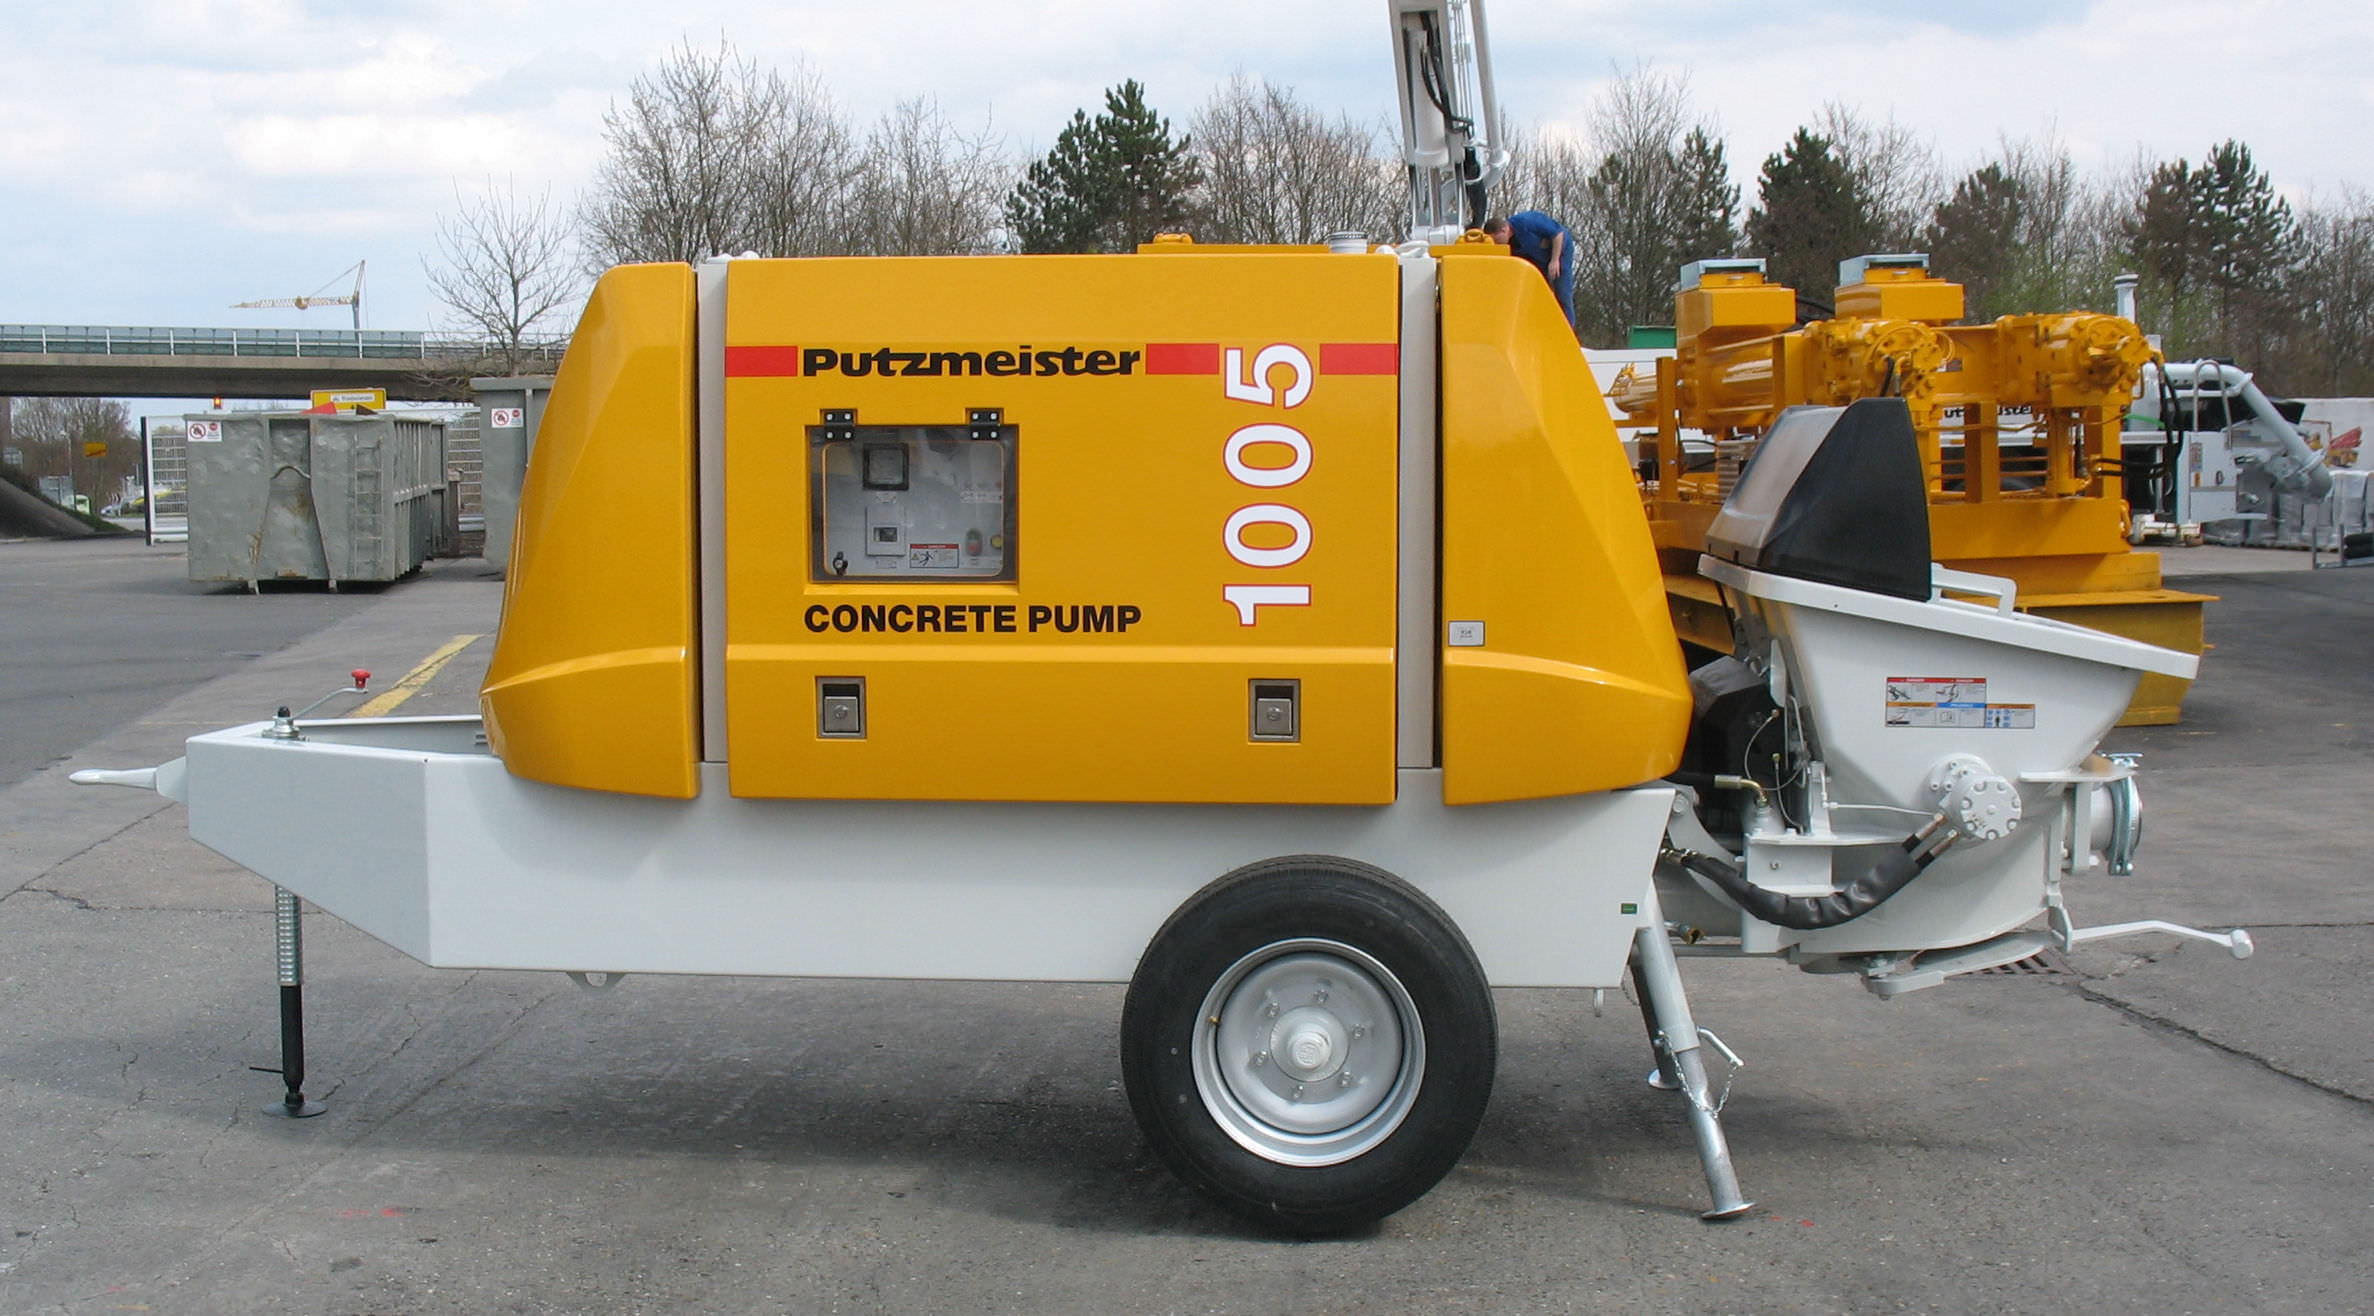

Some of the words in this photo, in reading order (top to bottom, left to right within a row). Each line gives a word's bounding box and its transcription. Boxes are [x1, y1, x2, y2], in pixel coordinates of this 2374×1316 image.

[803, 345, 1141, 377] Putzmeister
[1222, 342, 1314, 627] 1005
[804, 604, 1017, 633] CONCRETE
[1028, 604, 1142, 633] PUMP
